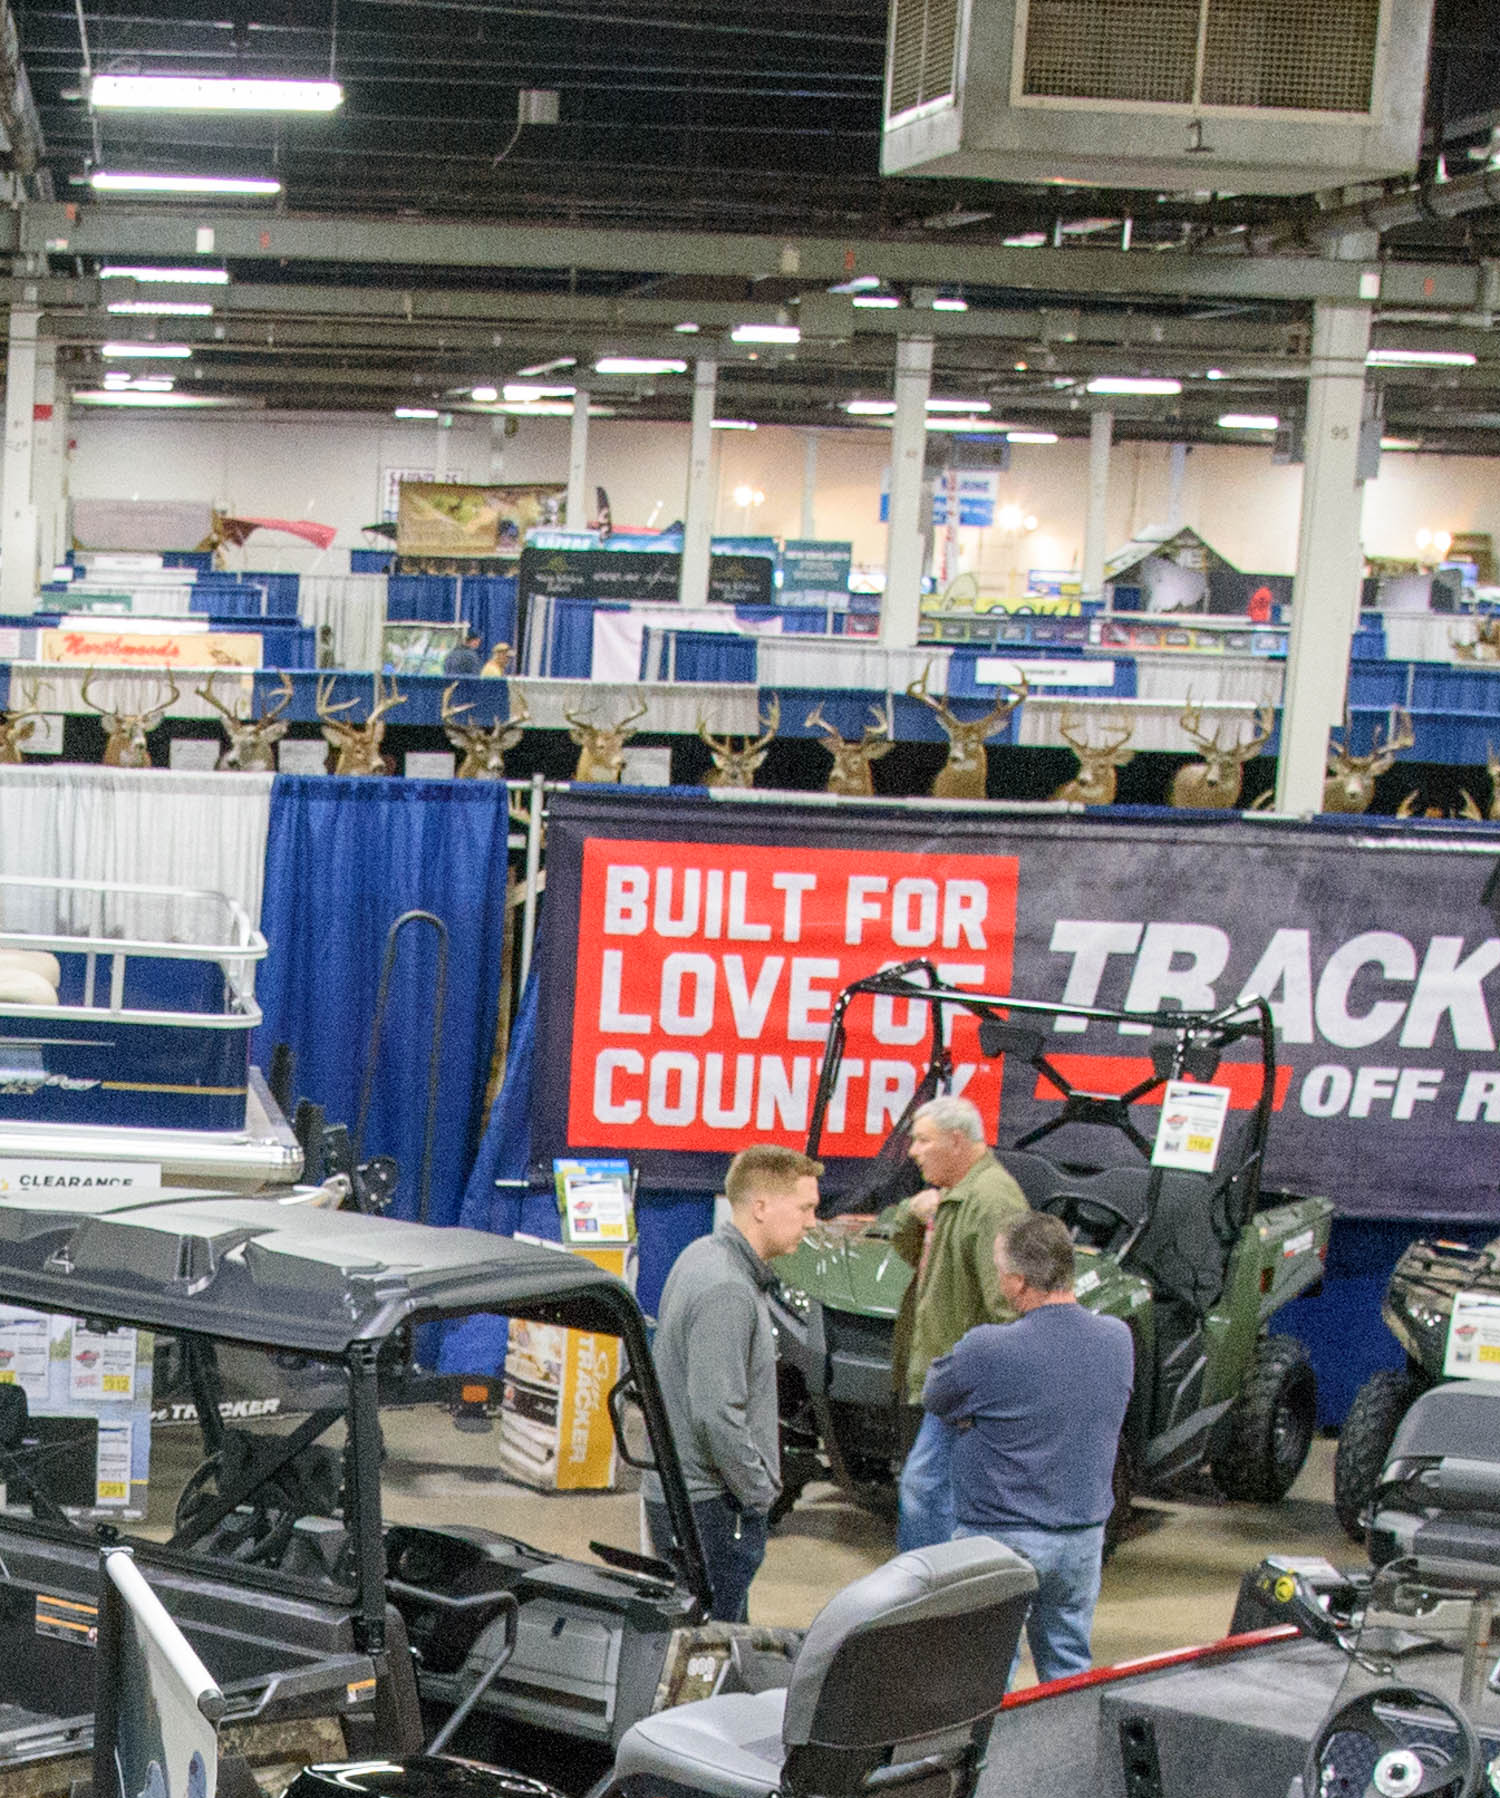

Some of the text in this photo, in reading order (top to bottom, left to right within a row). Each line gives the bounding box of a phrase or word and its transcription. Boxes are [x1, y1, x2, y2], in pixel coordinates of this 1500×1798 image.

[604, 865, 988, 949] BUILT FOR
[600, 949, 985, 1047] LOVE OF
[1302, 1065, 1443, 1120] OFF
[19, 1174, 135, 1188] CLEARANCE
[569, 1335, 597, 1463] TRACKER
